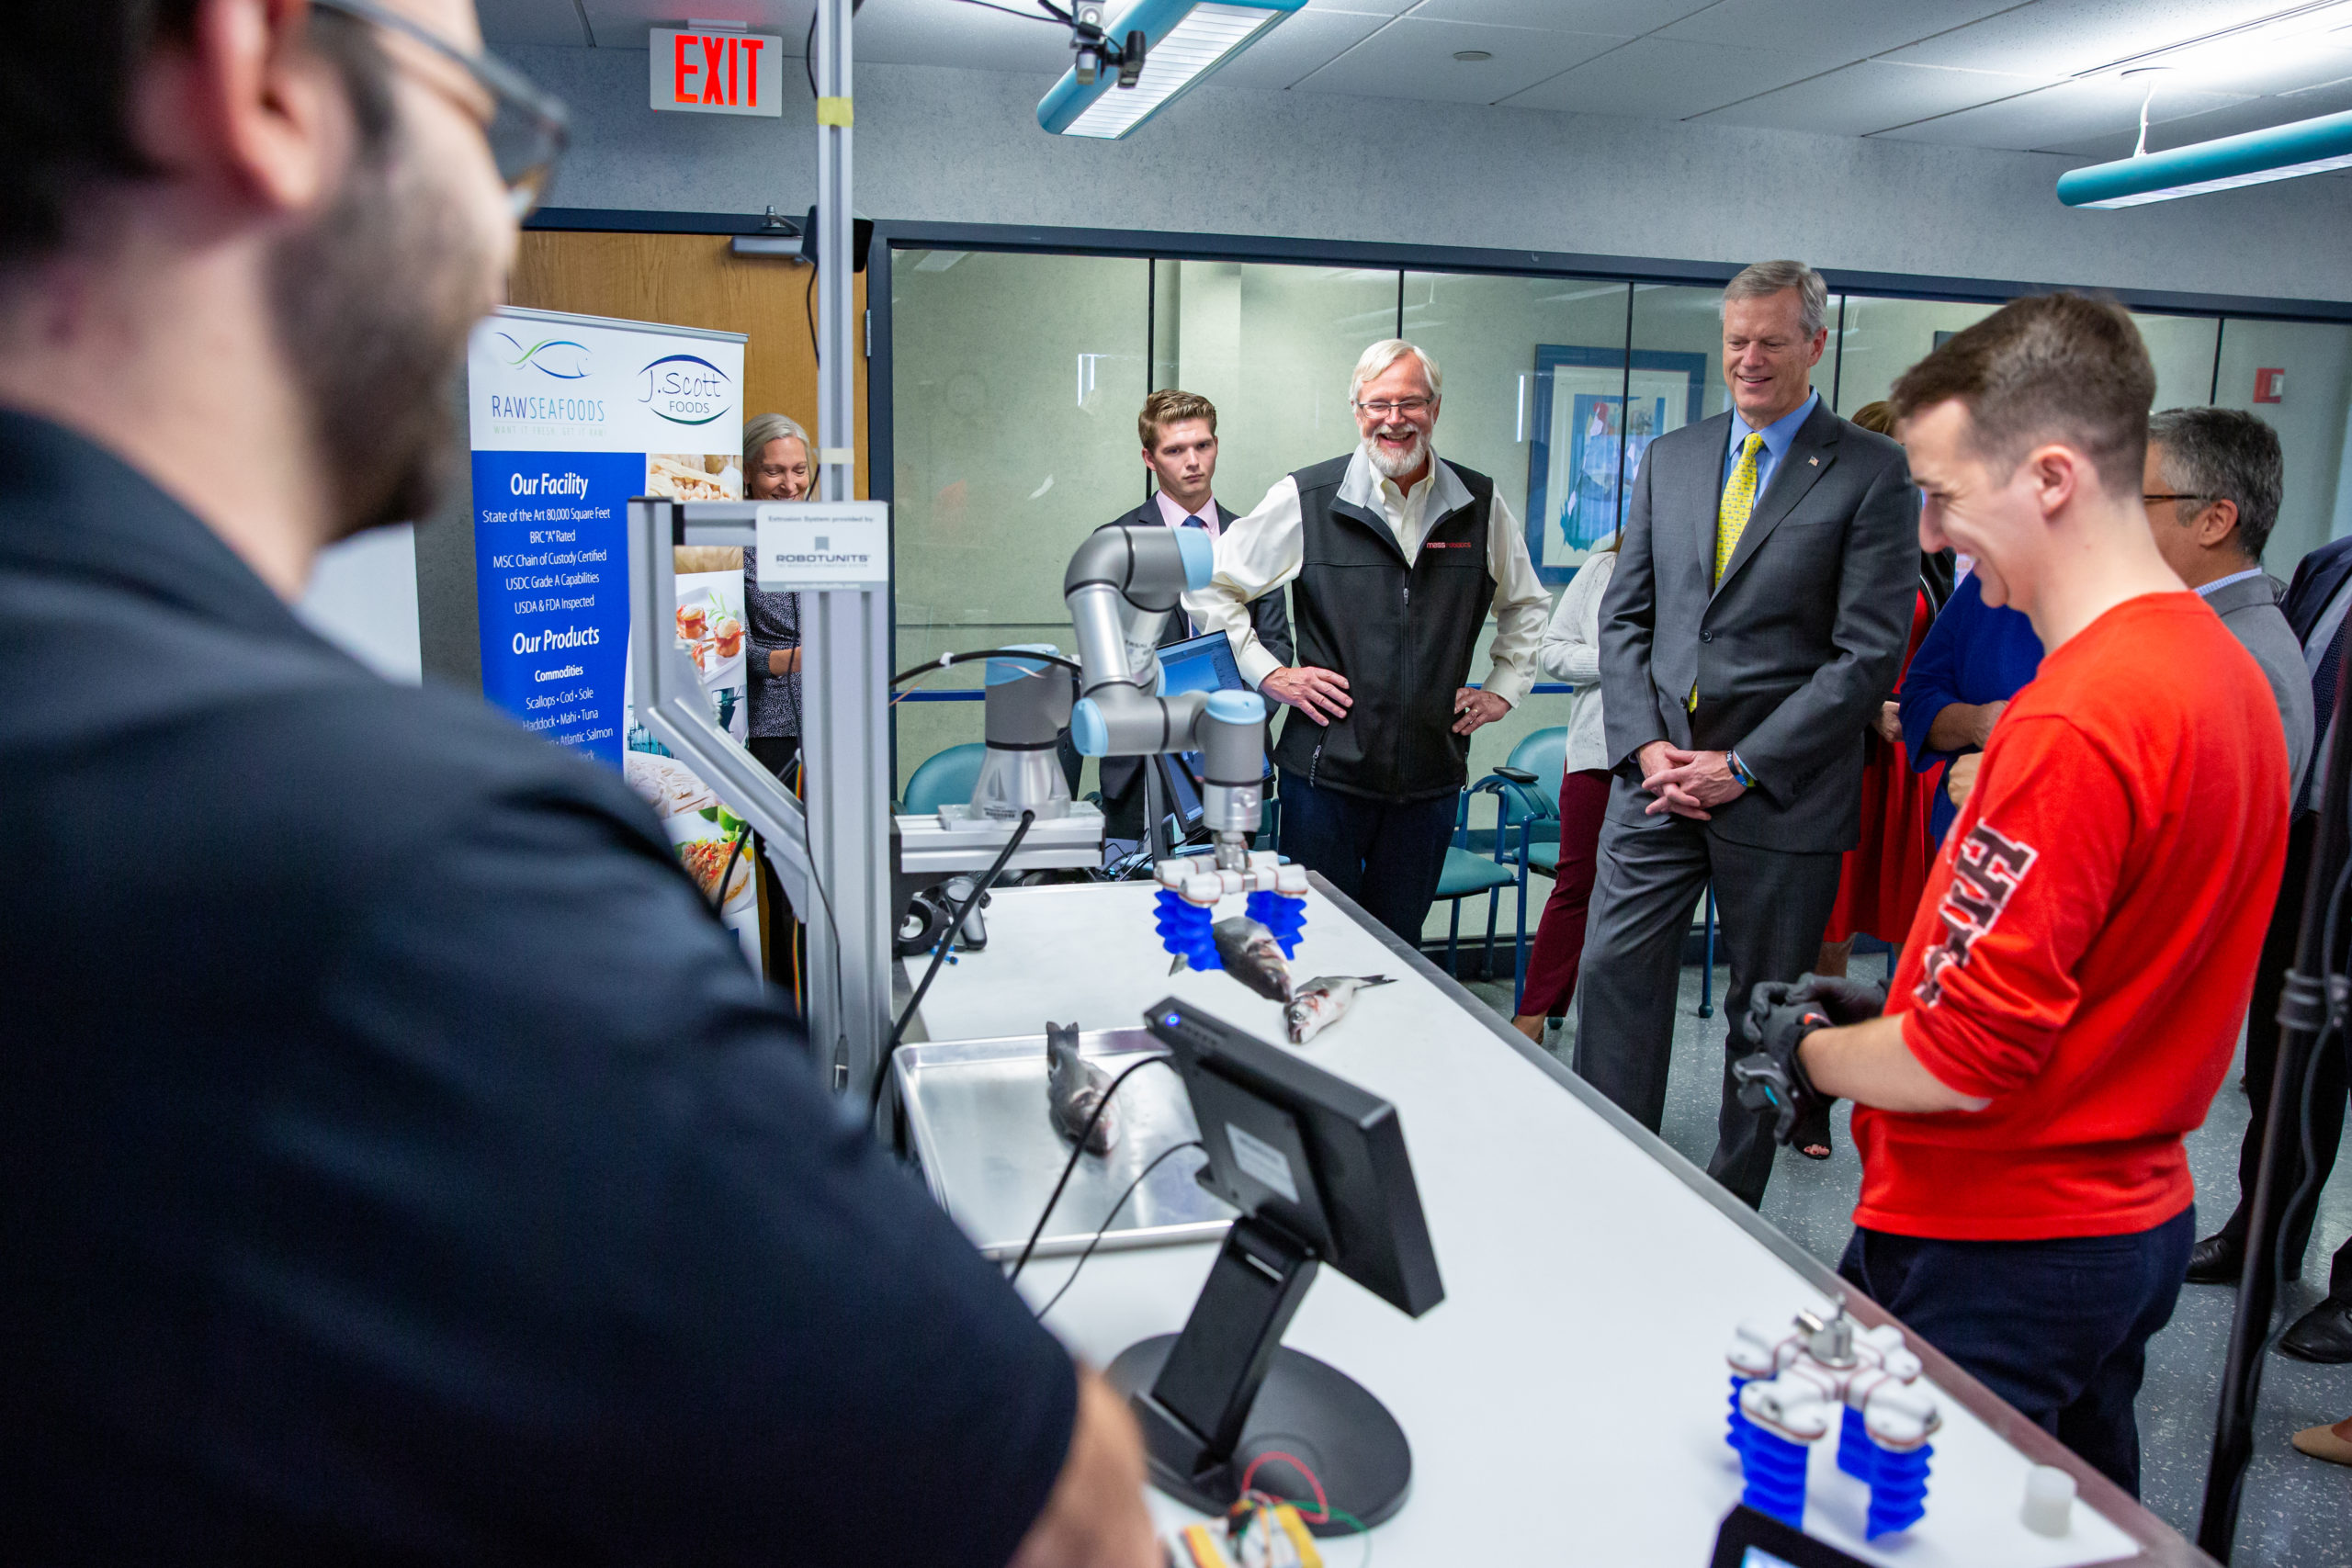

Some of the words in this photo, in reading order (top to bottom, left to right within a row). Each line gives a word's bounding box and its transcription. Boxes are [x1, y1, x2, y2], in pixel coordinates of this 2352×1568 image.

[675, 35, 763, 107] EXIT
[492, 395, 605, 421] RAWSEAFOODS
[670, 400, 710, 413] FOODS
[510, 472, 538, 496] Our
[540, 471, 589, 501] Facility
[482, 510, 507, 523] State
[509, 509, 518, 522] of
[519, 509, 532, 521] the
[534, 509, 545, 521] Art
[547, 508, 570, 522] 80,000
[571, 507, 594, 522] Square
[594, 507, 610, 519] Feet
[530, 531, 545, 544] BRC
[556, 529, 576, 542] Rated
[493, 555, 514, 569] MSC
[515, 554, 538, 567] Chain
[539, 552, 548, 566] of
[548, 551, 577, 566] Custody
[577, 548, 607, 562] Certified
[506, 577, 530, 591] USDC
[531, 575, 553, 588] Grade
[554, 575, 560, 587] A
[560, 571, 600, 588] Capabilities
[514, 601, 537, 615] USDA
[538, 600, 545, 612] &
[546, 598, 560, 611] FDA
[561, 593, 595, 611] Inspected
[512, 632, 541, 655] Our
[543, 626, 600, 651] Products
[535, 664, 583, 682] Commodities
[526, 694, 555, 710] Scallops
[560, 690, 574, 704] Cod
[579, 687, 594, 700] Sole
[560, 711, 577, 725] Mahi
[581, 708, 599, 721] Tuna
[560, 732, 585, 747] Atlantic
[587, 728, 614, 741] Salmon
